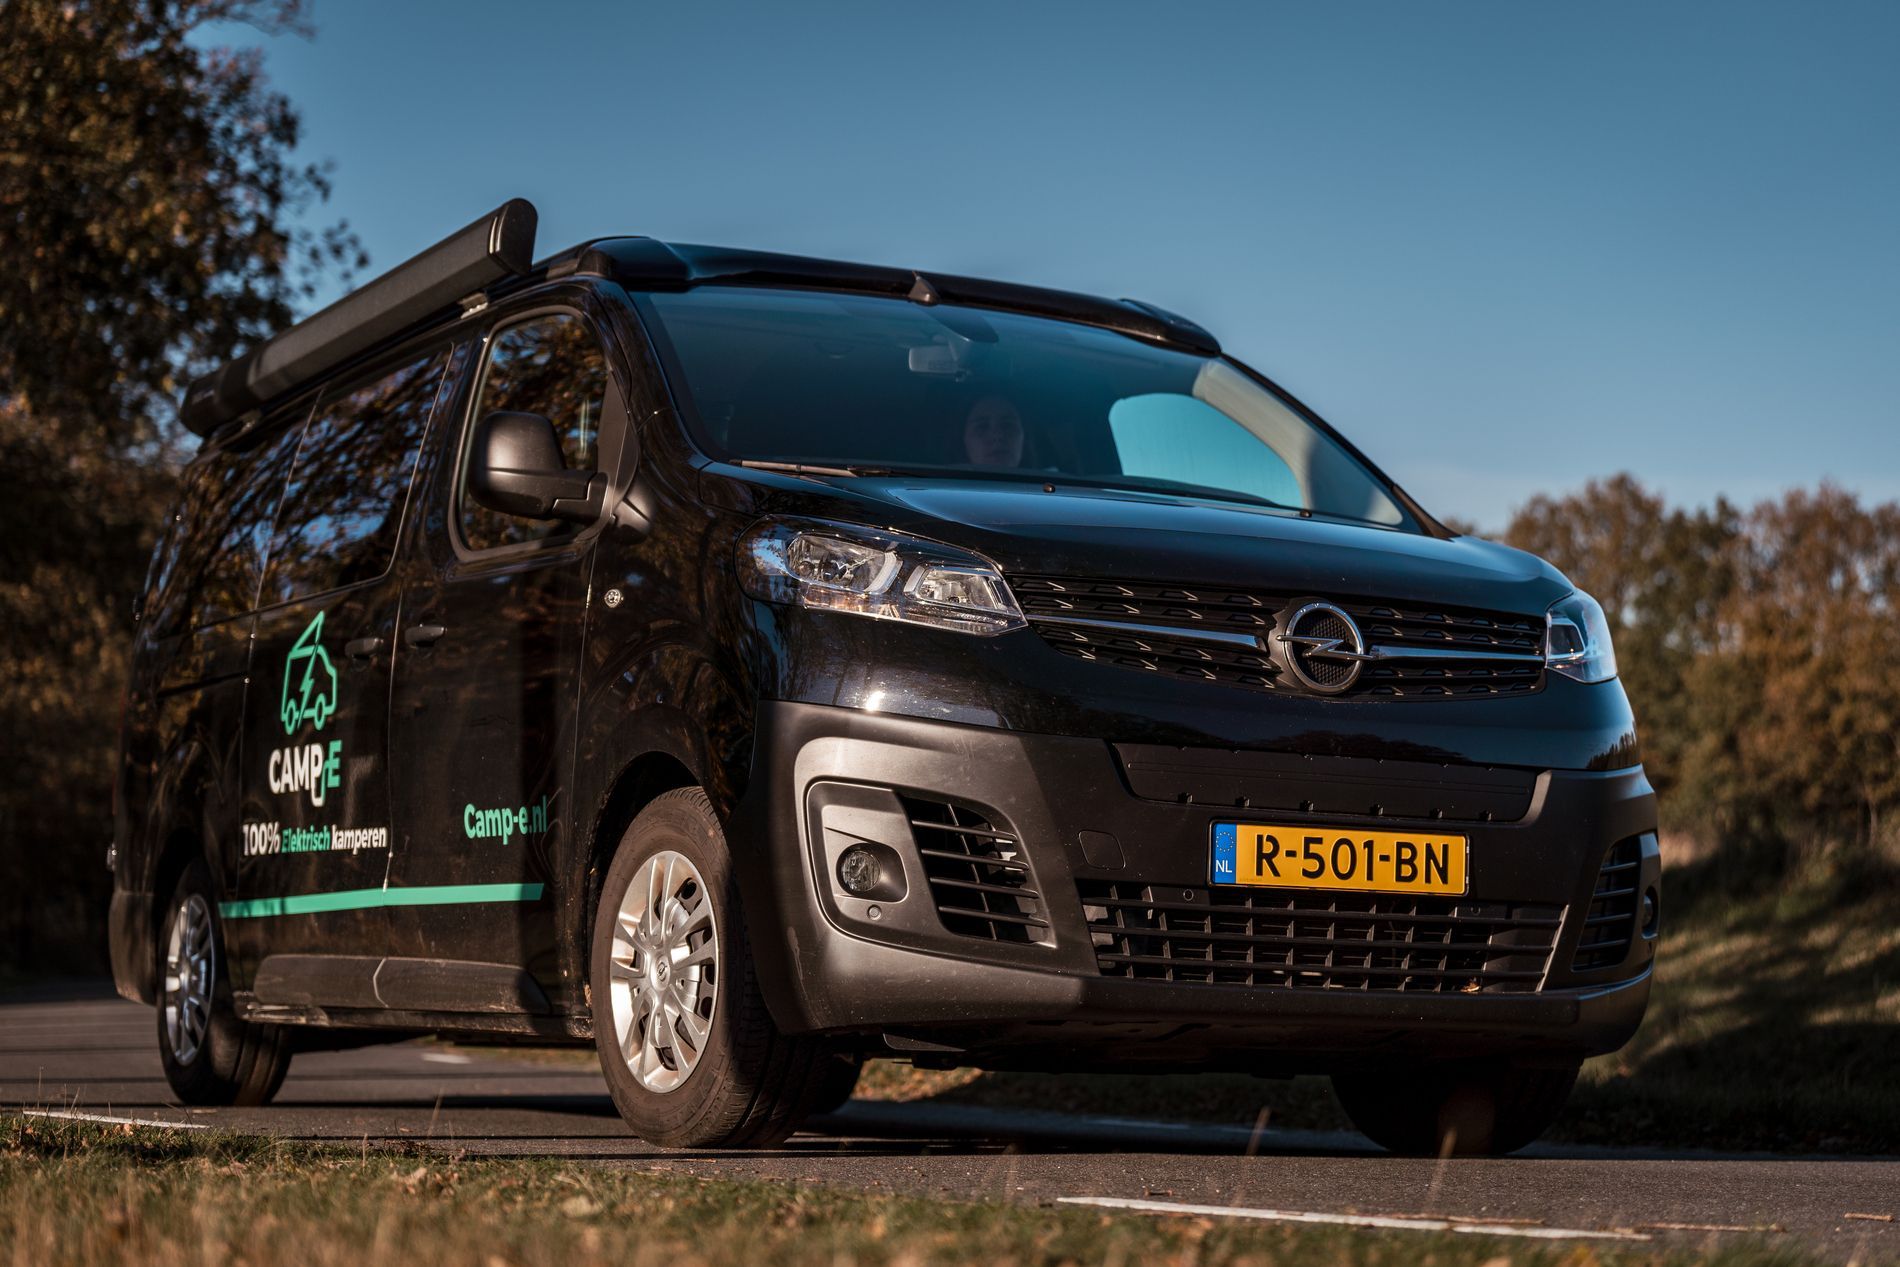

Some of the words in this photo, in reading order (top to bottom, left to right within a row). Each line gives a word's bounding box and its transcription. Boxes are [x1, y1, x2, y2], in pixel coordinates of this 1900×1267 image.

[243, 821, 281, 856] 100%
[281, 825, 331, 853] Elektrisch
[331, 824, 387, 855] kamperen
[464, 795, 547, 845] Camp-e.nl
[1215, 860, 1233, 873] NL
[1255, 834, 1449, 885] R-501-BN
